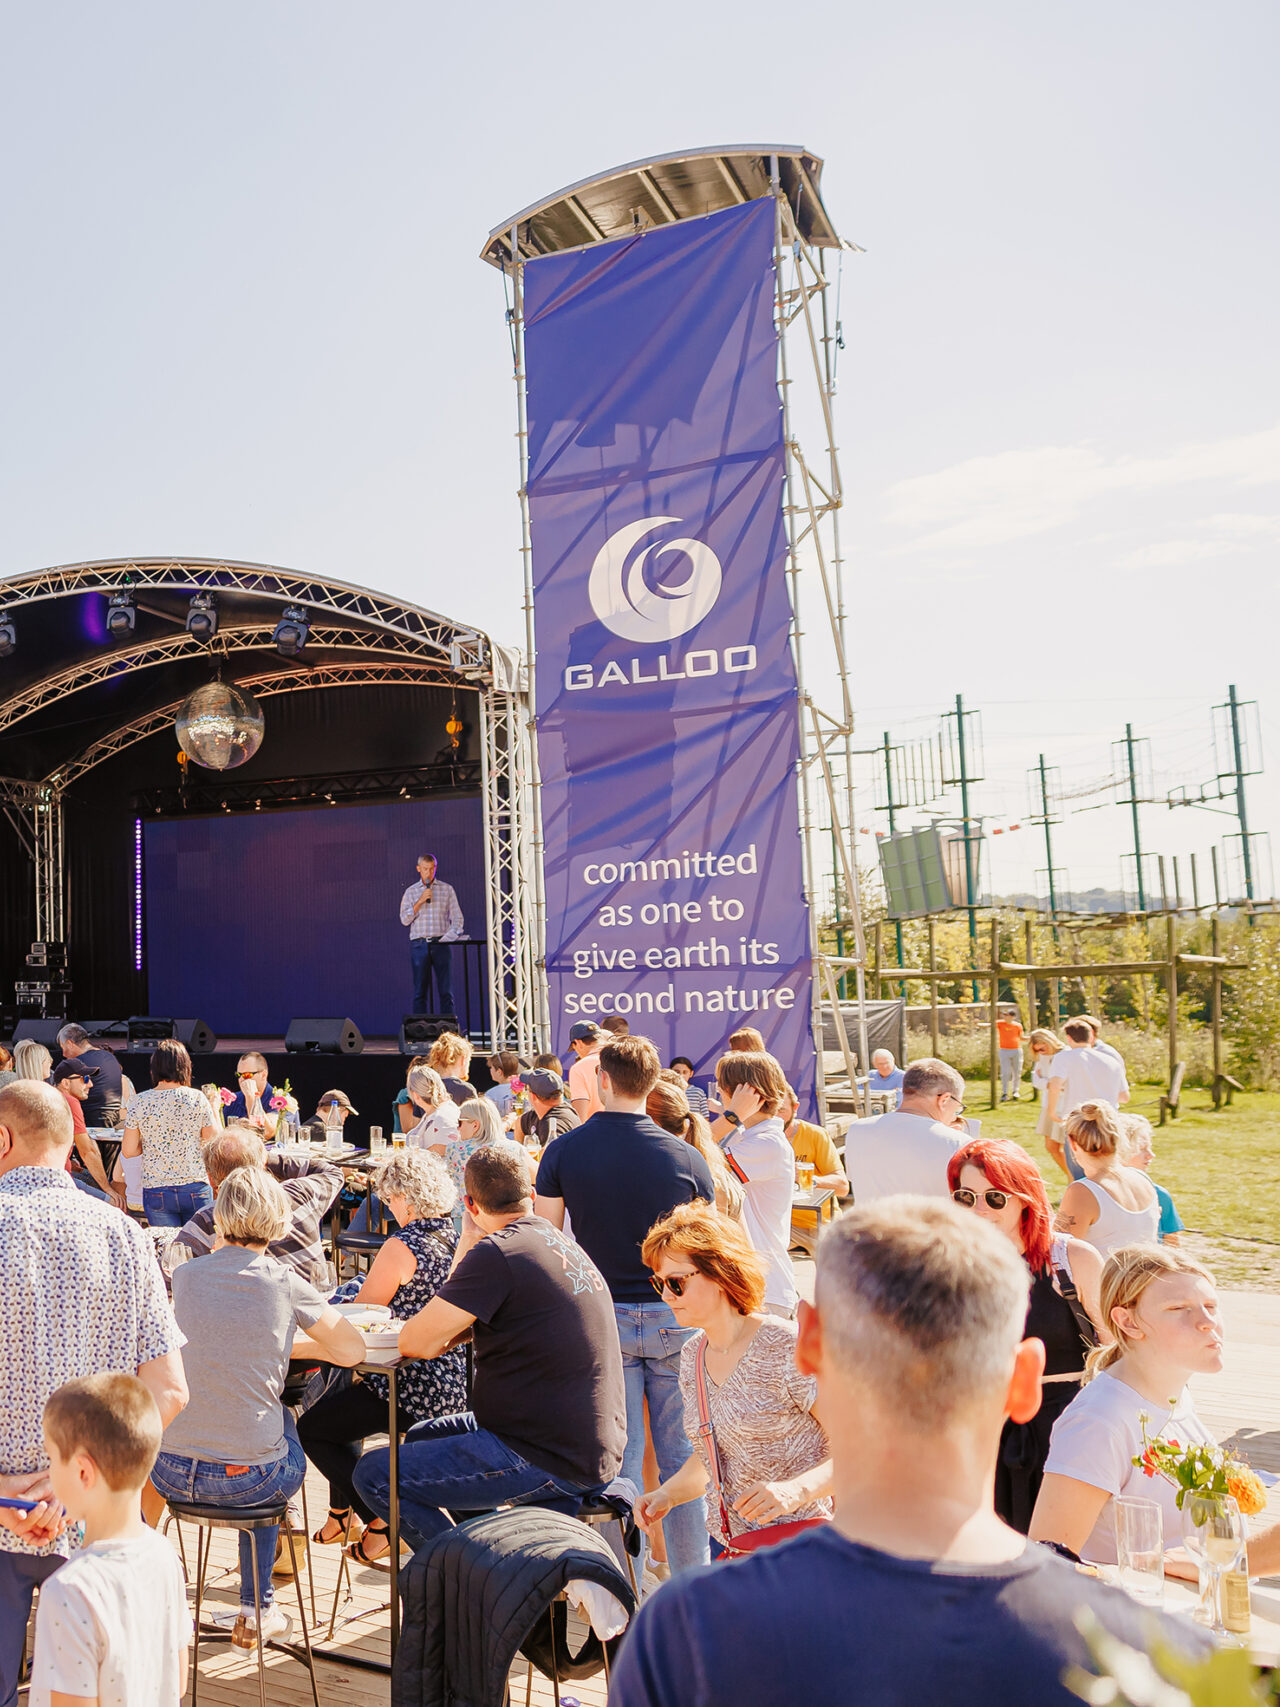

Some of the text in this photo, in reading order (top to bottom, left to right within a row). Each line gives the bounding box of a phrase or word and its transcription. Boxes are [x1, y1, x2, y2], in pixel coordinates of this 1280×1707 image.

[564, 644, 757, 691] GALLOO
[583, 843, 758, 885] committed
[598, 894, 745, 927] as one to
[573, 936, 780, 979] give earth its
[564, 983, 796, 1015] second nature
